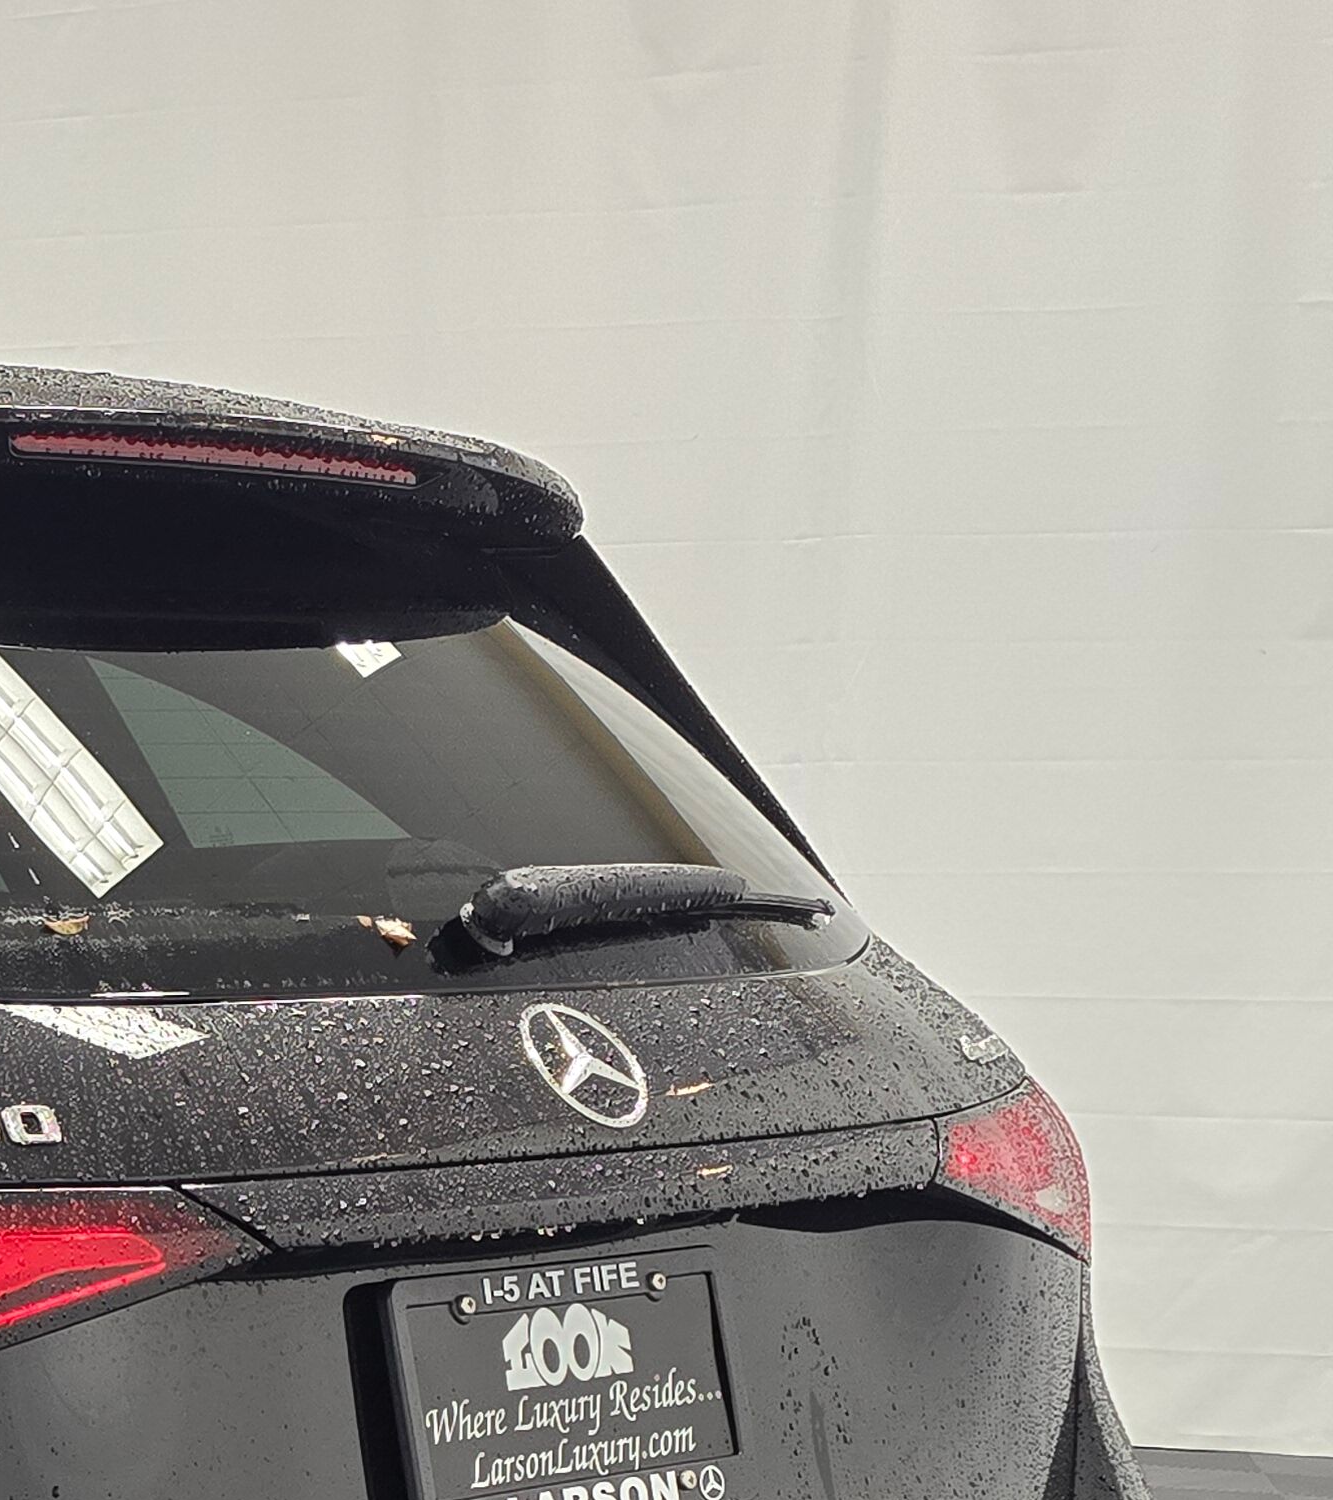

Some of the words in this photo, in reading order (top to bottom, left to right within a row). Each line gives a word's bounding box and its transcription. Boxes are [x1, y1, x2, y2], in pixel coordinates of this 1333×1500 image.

[482, 1276, 521, 1304] I-5
[528, 1269, 565, 1299] AT
[574, 1262, 640, 1294] FIFE
[425, 1400, 507, 1446] Where
[514, 1390, 601, 1436] Luxury
[470, 1425, 696, 1489] LarsonLuxury.com
